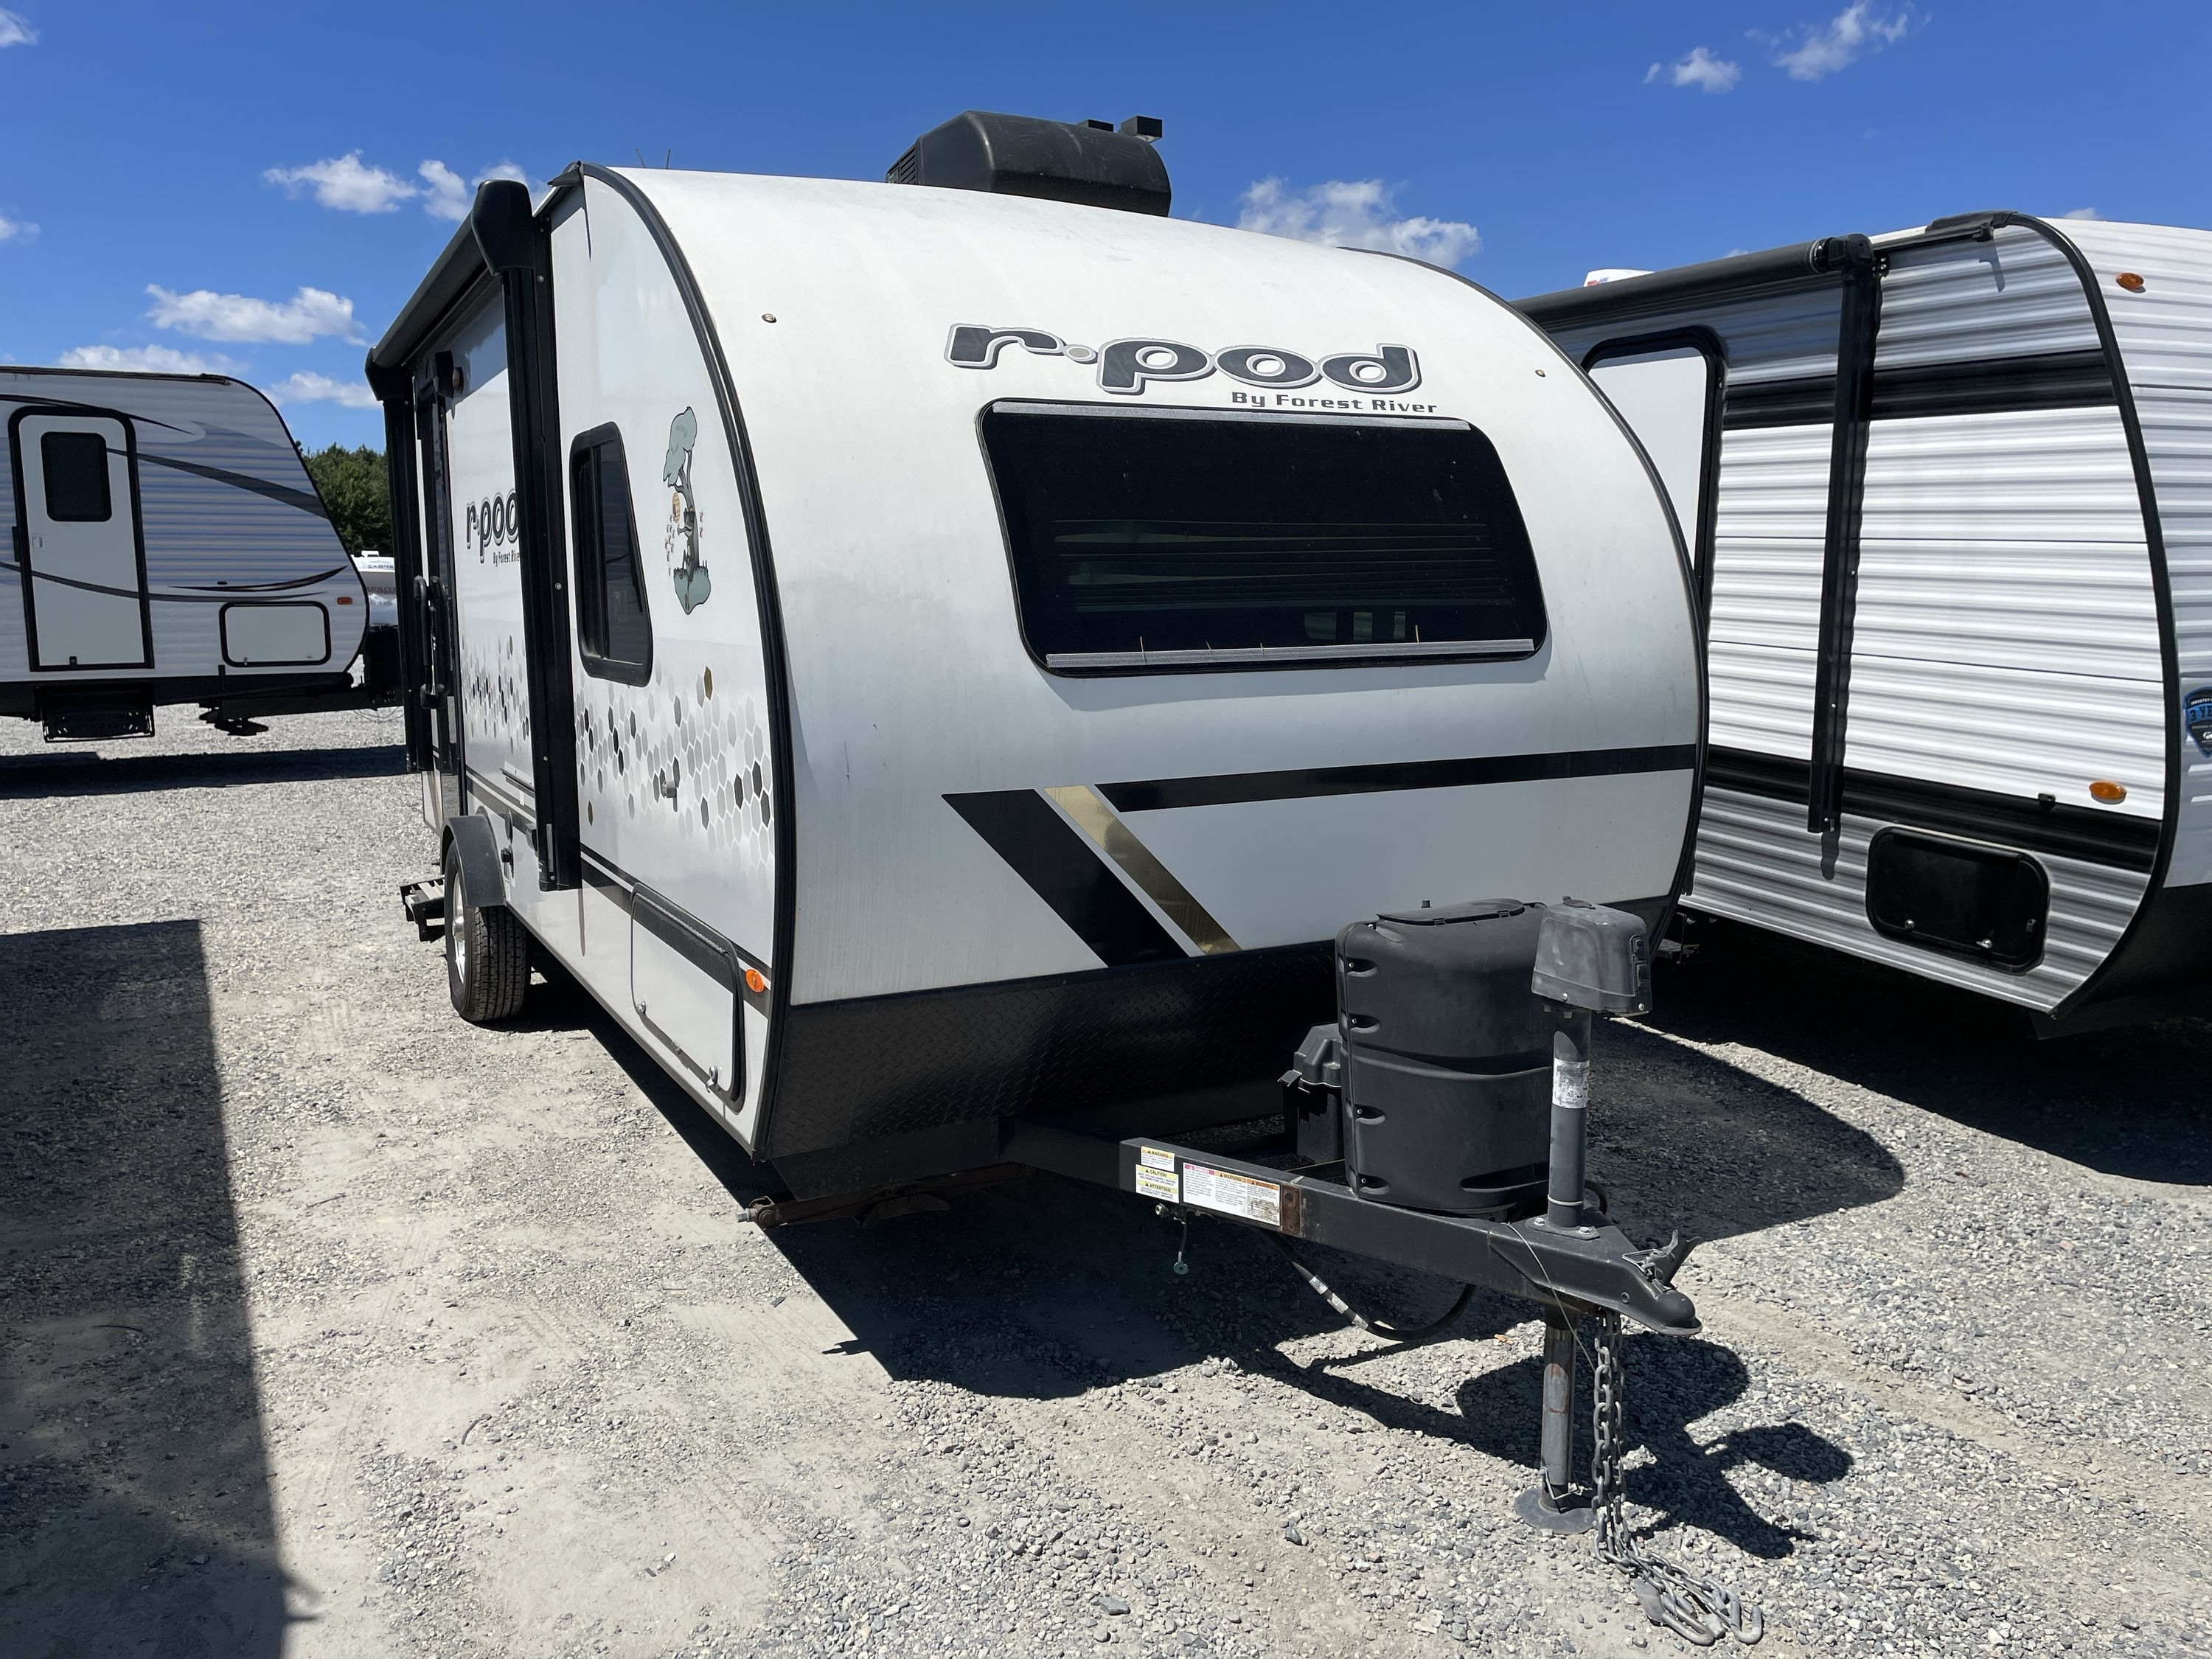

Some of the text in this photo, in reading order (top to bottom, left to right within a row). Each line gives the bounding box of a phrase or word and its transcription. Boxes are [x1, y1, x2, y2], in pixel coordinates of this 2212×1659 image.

[1232, 391, 1438, 414] By Forest River
[498, 552, 510, 564] Forest
[511, 550, 520, 562] Rive
[1150, 1169, 1167, 1178] CAUTION
[1150, 1183, 1171, 1192] ATTENTION
